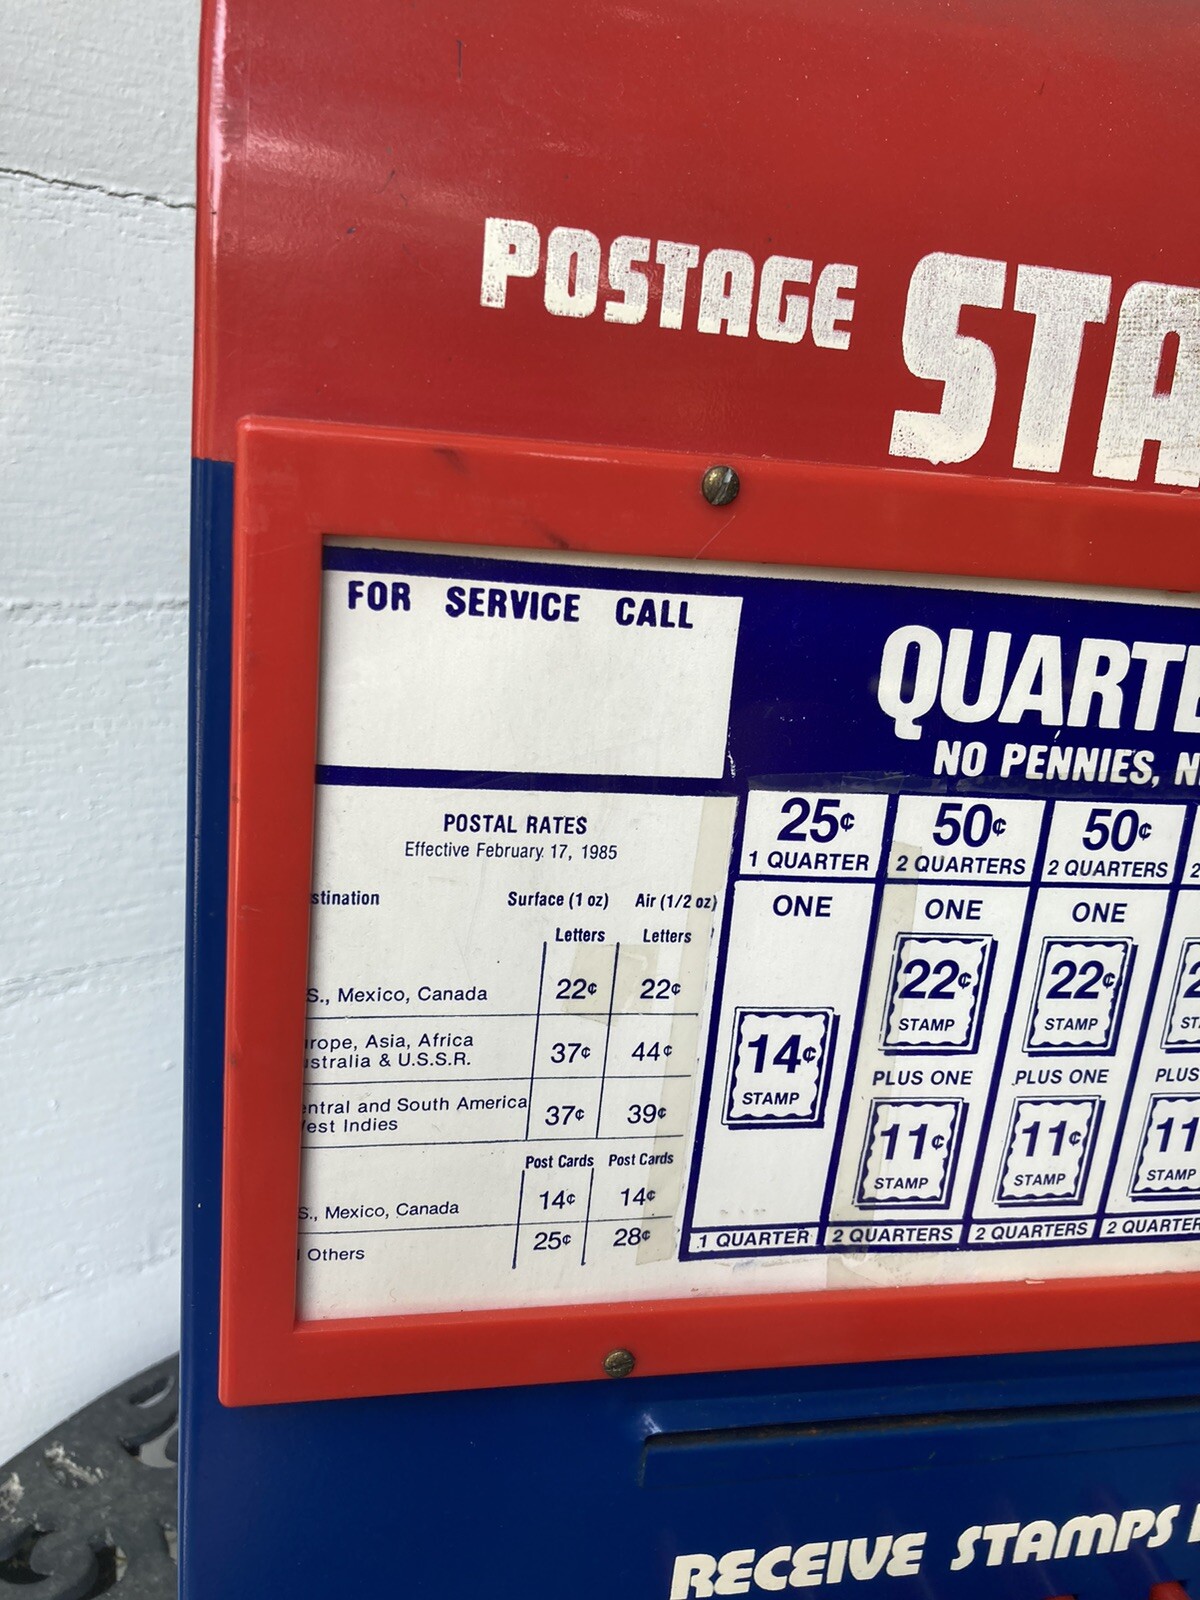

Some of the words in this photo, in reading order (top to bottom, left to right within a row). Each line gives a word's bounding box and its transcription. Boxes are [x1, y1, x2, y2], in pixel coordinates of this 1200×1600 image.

[480, 216, 859, 351] POSTAGE
[889, 251, 1200, 487] STA
[348, 581, 410, 611] FOR
[446, 586, 580, 622] SERVICE
[616, 597, 693, 629] CALL
[933, 739, 987, 777] NO
[1000, 743, 1159, 787] PENNIES,
[444, 814, 517, 833] POSTAL
[527, 815, 587, 834] RATES
[777, 797, 854, 843] 25¢
[933, 803, 1006, 847] 50¢
[1083, 809, 1152, 851] 50¢
[406, 841, 469, 857] Effective
[477, 843, 544, 861] February
[551, 844, 572, 861] 17,
[582, 845, 617, 859] 1985
[749, 851, 757, 867] 1
[768, 851, 869, 871] QUARTER
[896, 855, 908, 871] 2
[915, 855, 1025, 875] QUARTERS
[1048, 860, 1059, 875] 2
[1065, 860, 1168, 878] QUARTERS
[311, 890, 380, 905] stination
[508, 891, 564, 906] Surface
[569, 892, 582, 910] (1
[588, 893, 608, 910] oz)
[635, 893, 656, 907] Air
[661, 894, 691, 911] (1/2
[696, 895, 717, 911] oz)
[773, 895, 832, 917] ONE
[925, 899, 983, 920] ONE
[1072, 902, 1127, 922] ONE
[556, 928, 605, 942] Letters
[643, 929, 691, 943] Letters
[899, 959, 971, 999] 22¢
[1046, 960, 1115, 999] 22¢
[338, 987, 409, 1004] Mexico,
[418, 986, 487, 1001] Canada
[556, 978, 597, 999] 22¢
[640, 979, 681, 999] 22¢
[899, 1018, 955, 1031] STAMP
[1045, 1018, 1098, 1030] STAMP
[366, 1034, 410, 1049] Asia,
[418, 1033, 473, 1047] Africa
[379, 1054, 391, 1067] &
[399, 1052, 470, 1066] U.S.S.R.
[551, 1043, 590, 1063] 37¢
[632, 1042, 672, 1061] 44¢
[748, 1034, 816, 1073] 14¢
[873, 1071, 923, 1085] PLUS
[931, 1071, 973, 1085] ONE
[1015, 1070, 1062, 1084] PLUS
[1069, 1069, 1109, 1084] ONE
[1155, 1068, 1199, 1082] PLUS
[358, 1099, 390, 1113] and
[397, 1097, 450, 1112] South
[457, 1095, 527, 1110] America
[742, 1092, 799, 1105] STAMP
[545, 1106, 584, 1125] 37¢
[627, 1104, 666, 1124] 39¢
[344, 1118, 397, 1132] Indies
[881, 1124, 944, 1160] 11¢
[1022, 1121, 1081, 1156] 11¢
[1157, 1117, 1199, 1152] 11
[526, 1156, 553, 1169] Post
[558, 1154, 594, 1168] Cards
[609, 1154, 635, 1166] Post
[640, 1152, 673, 1165] Cards
[874, 1178, 928, 1189] STAMP
[1014, 1174, 1065, 1186] STAMP
[1147, 1169, 1196, 1181] STAMP
[540, 1190, 575, 1210] 14¢
[621, 1188, 655, 1206] 14¢
[326, 1205, 388, 1219] Mexico,
[397, 1201, 459, 1216] Canada
[832, 1229, 843, 1242] 2
[849, 1227, 953, 1242] QUARTERS
[975, 1228, 985, 1240] 2
[992, 1222, 1087, 1240] QUARTERS
[1107, 1221, 1117, 1234] 2
[533, 1232, 571, 1250] 25¢
[613, 1228, 650, 1246] 28¢
[700, 1235, 706, 1248] 1
[716, 1230, 810, 1247] QUARTER
[307, 1248, 365, 1261] Others
[670, 1532, 927, 1600] RECEIVE
[950, 1504, 1181, 1571] STAMPS
